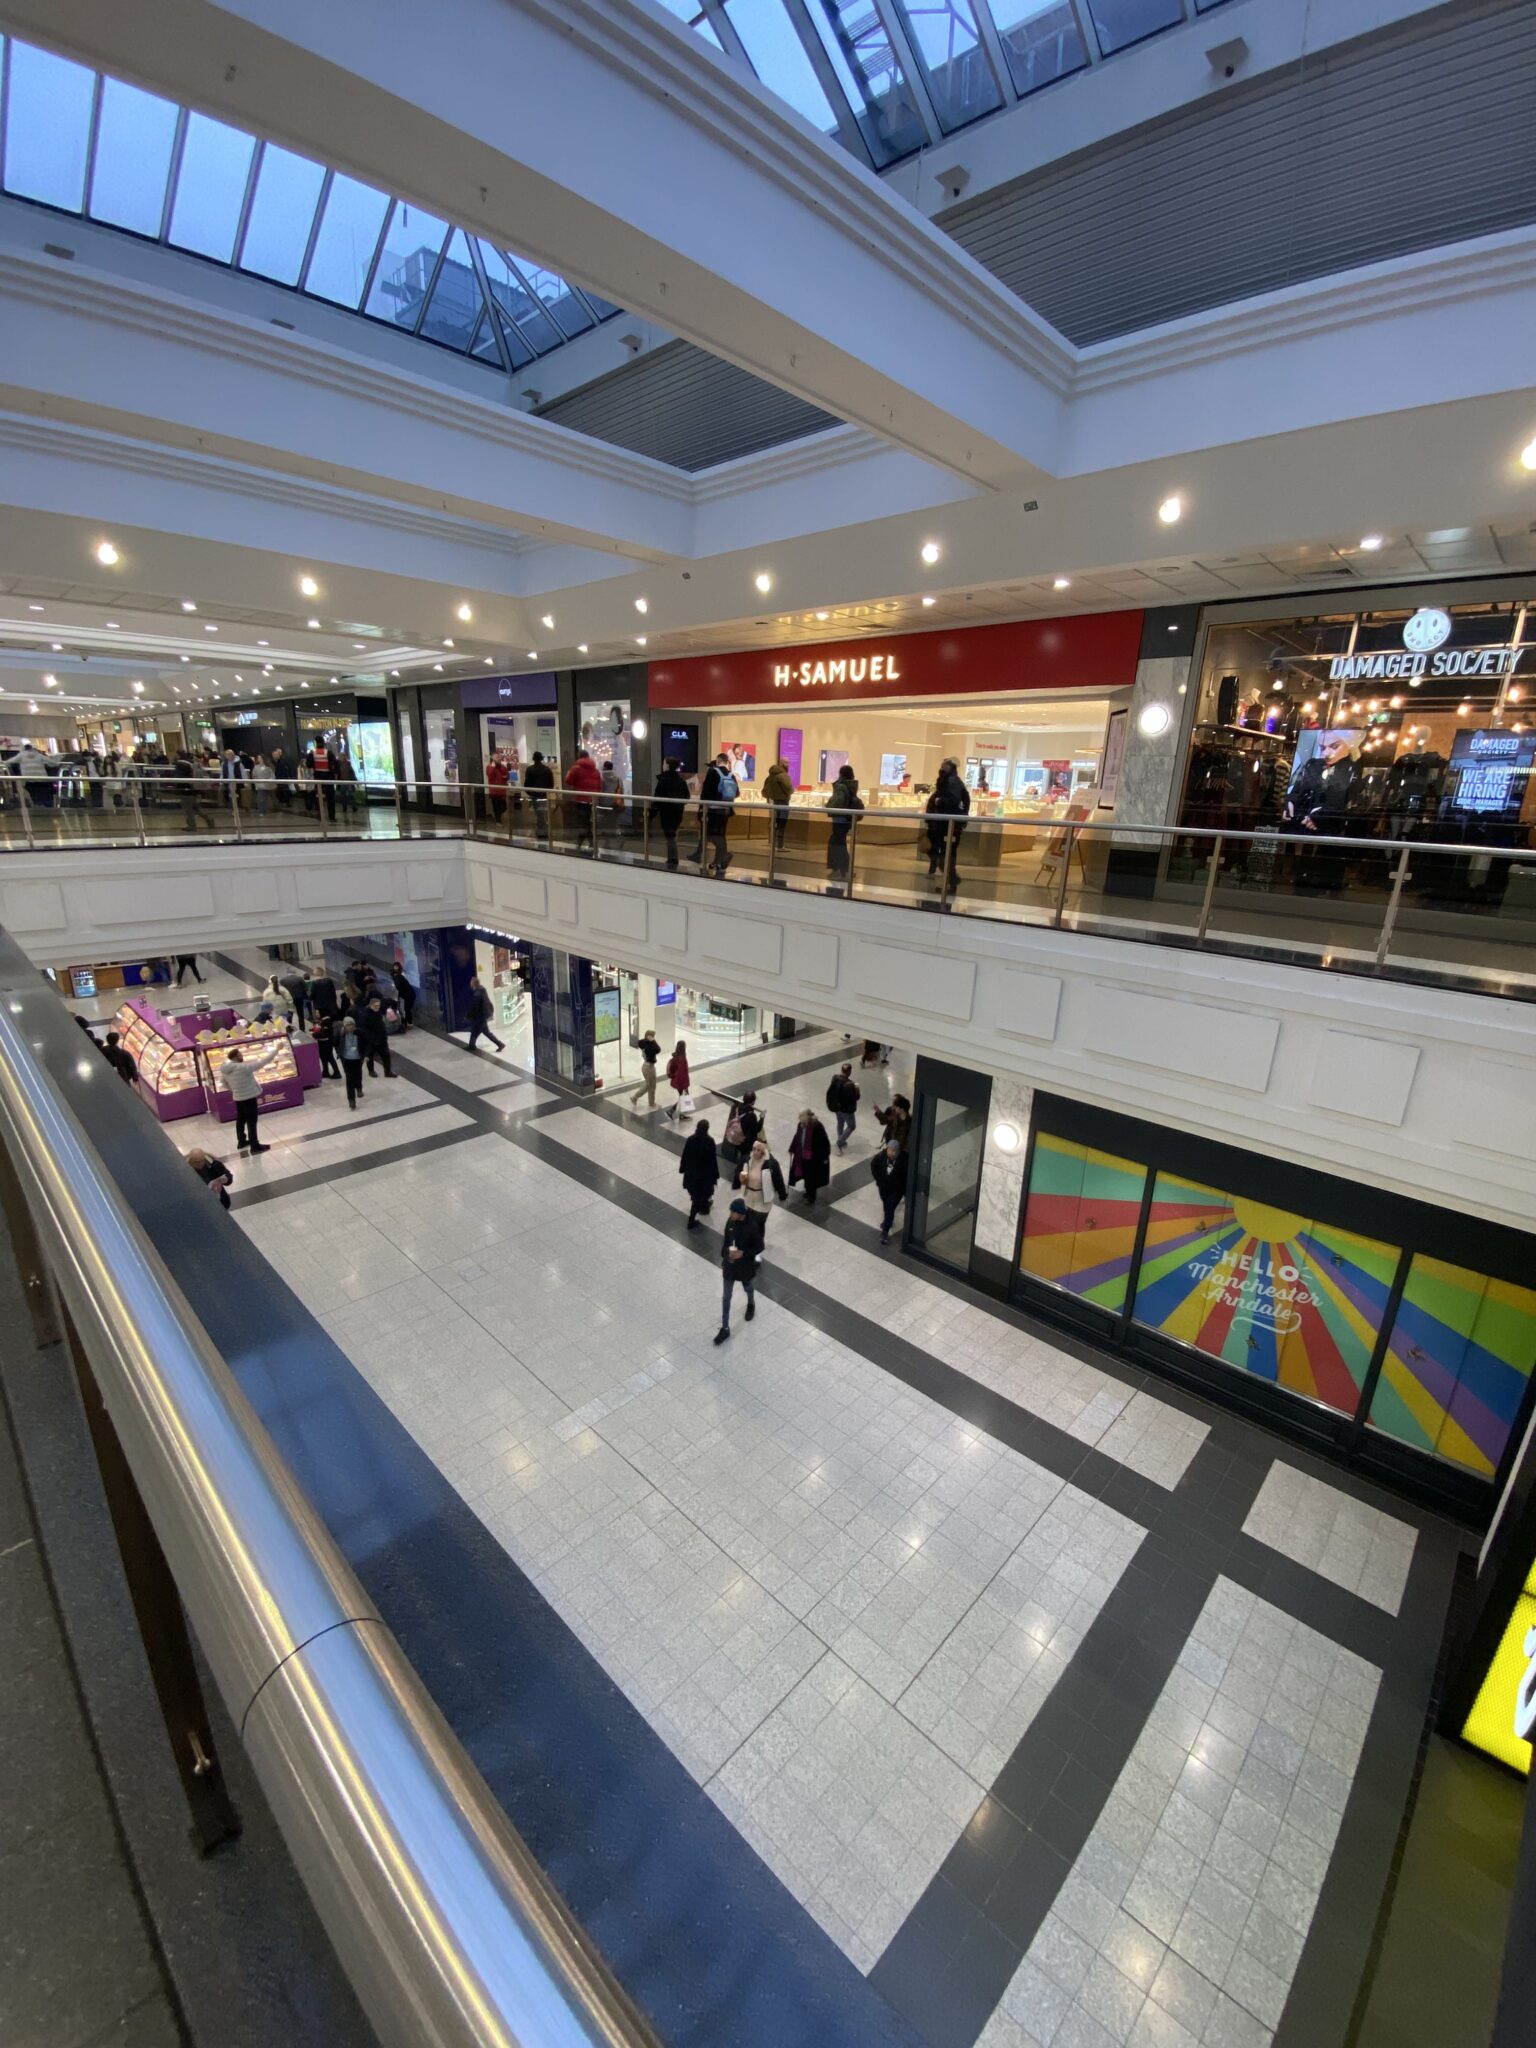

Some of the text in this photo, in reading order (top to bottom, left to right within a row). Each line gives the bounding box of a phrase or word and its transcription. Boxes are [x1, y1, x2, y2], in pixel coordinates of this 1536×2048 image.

[799, 655, 900, 685] SAMUEL
[1329, 653, 1426, 680] DAMAGED
[1470, 738, 1519, 750] DAMAGED
[1458, 783, 1508, 799] HIRING
[1462, 769, 1513, 785] WE ARE
[1221, 1250, 1299, 1282] HELLO
[1188, 1262, 1323, 1307] Manchester
[1203, 1286, 1297, 1326] Arndale
